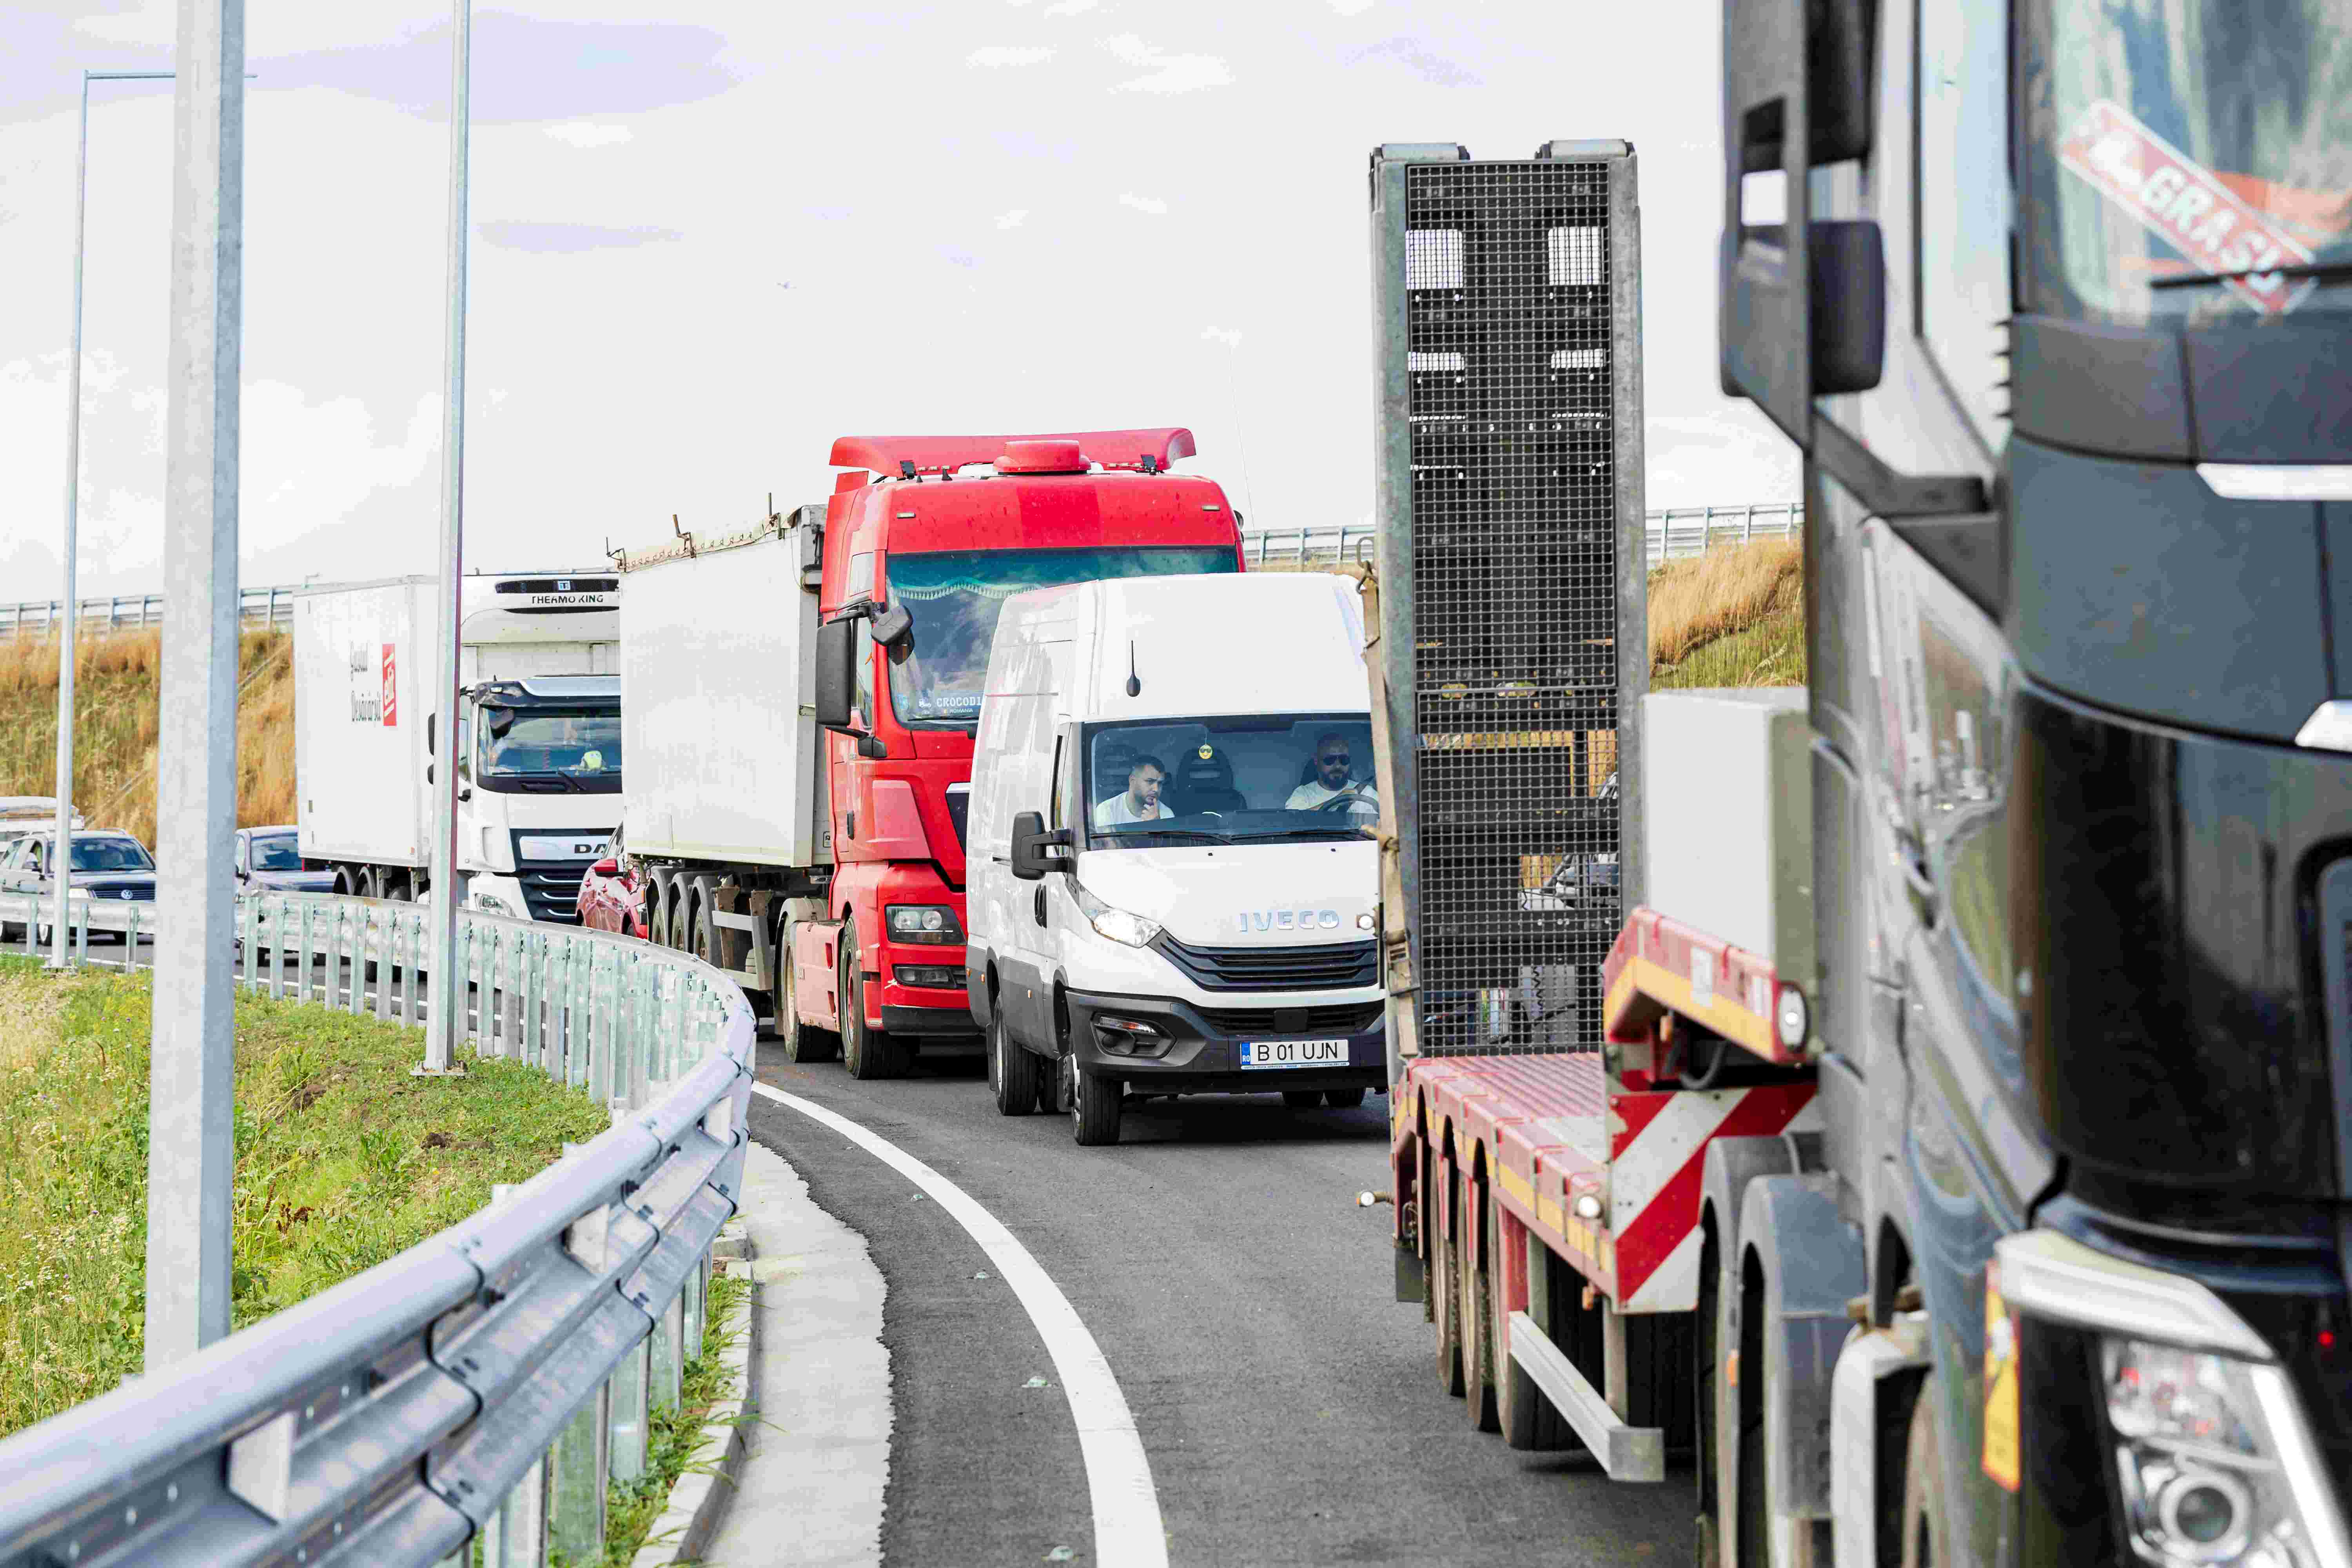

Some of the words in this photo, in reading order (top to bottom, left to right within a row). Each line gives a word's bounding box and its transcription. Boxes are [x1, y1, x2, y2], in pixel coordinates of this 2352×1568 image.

[532, 595, 575, 604] THERMO
[579, 594, 603, 603] KING
[1239, 910, 1339, 931] IVECO
[1258, 1045, 1269, 1061] B
[1277, 1044, 1293, 1060] 01
[1303, 1042, 1338, 1060] UJN
